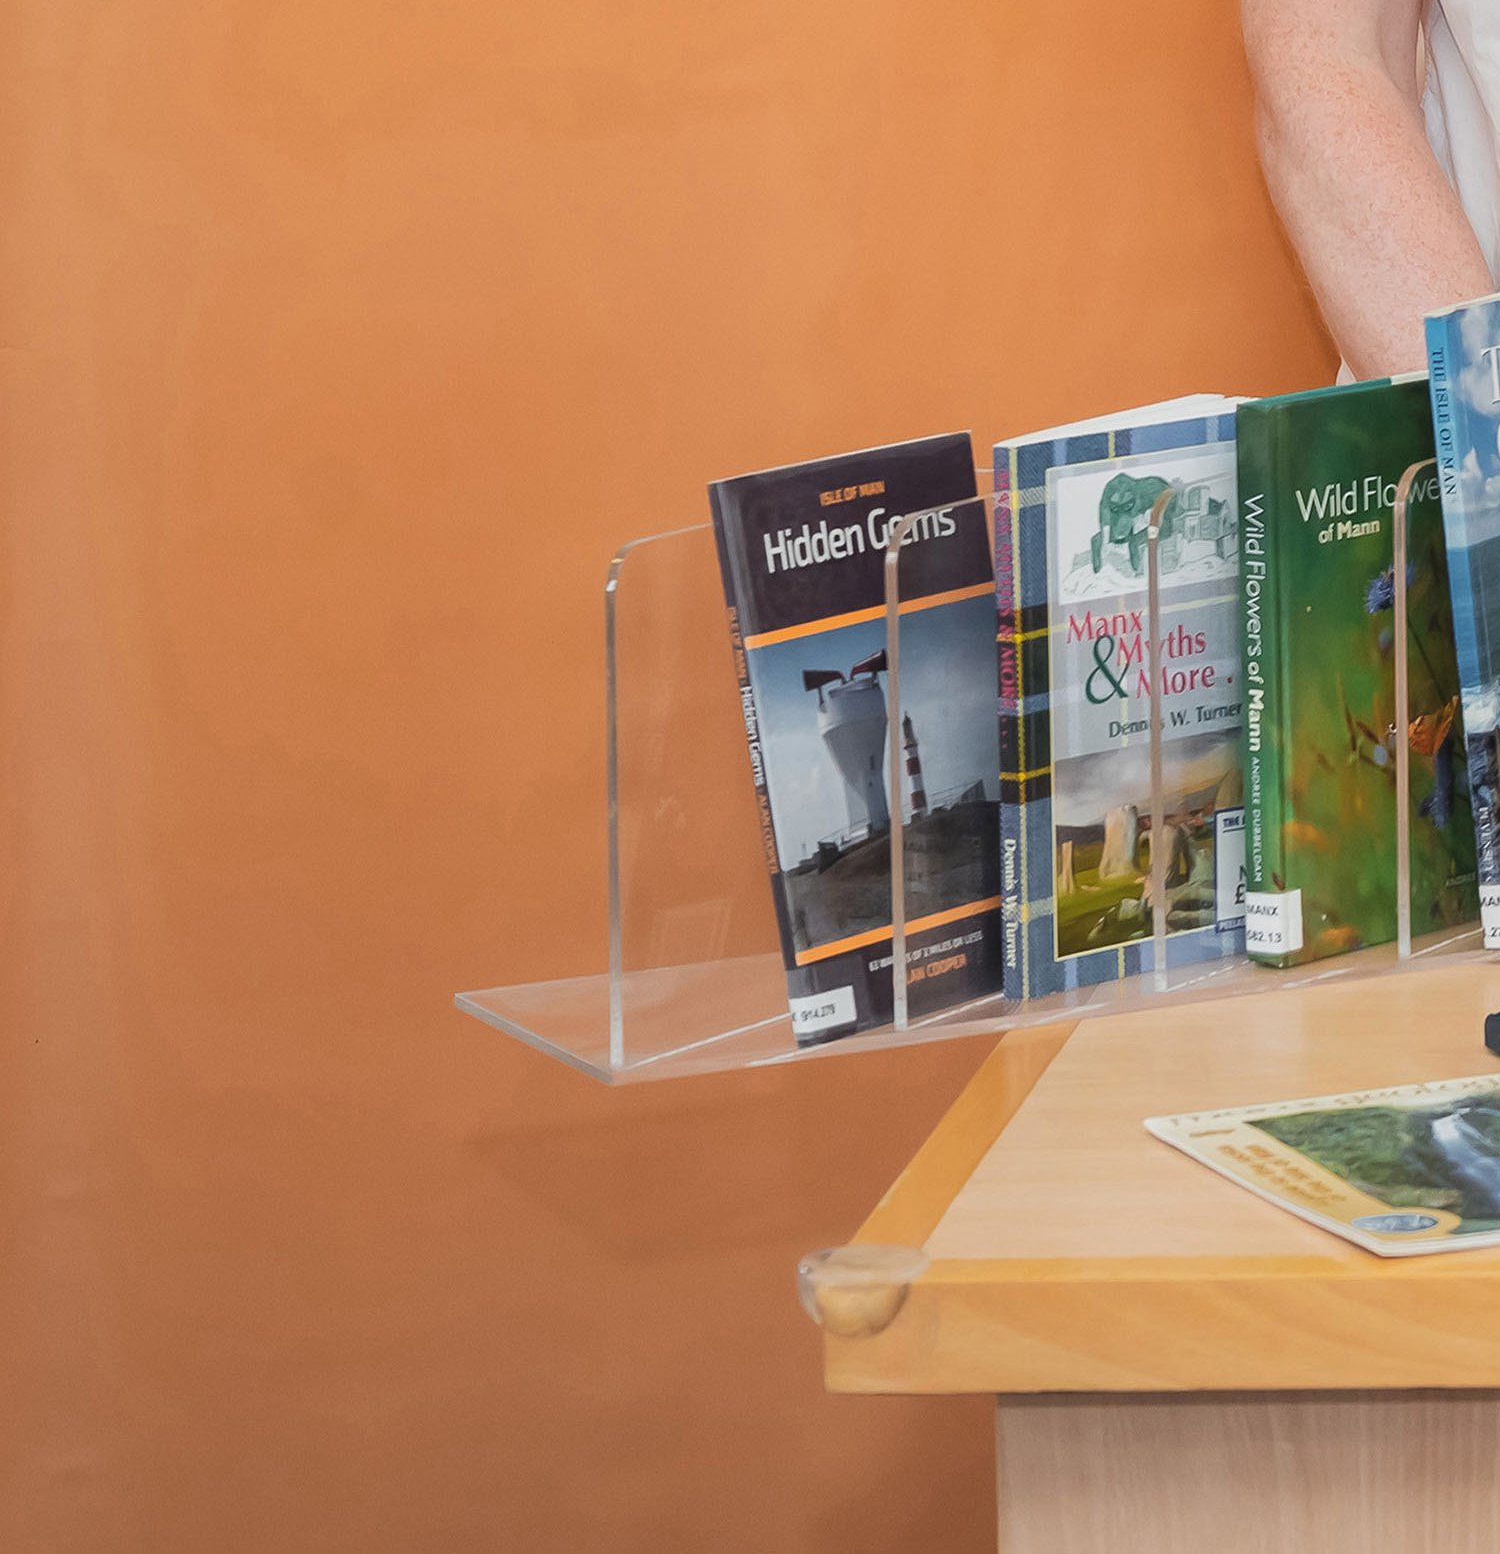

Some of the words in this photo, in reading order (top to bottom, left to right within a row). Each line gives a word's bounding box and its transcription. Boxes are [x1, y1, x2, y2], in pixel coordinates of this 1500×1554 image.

[1243, 493, 1265, 556] Wild
[1295, 480, 1358, 523] Wild
[1364, 475, 1441, 512] Flowe
[763, 520, 865, 574] Hidden
[1318, 523, 1335, 544] of
[1336, 518, 1381, 541] Mann
[1066, 610, 1144, 645] Manx
[1245, 559, 1266, 658] Flowers
[1085, 634, 1131, 706] &
[1247, 660, 1265, 686] of
[1169, 709, 1191, 728] W.
[1196, 702, 1243, 723] Turner
[1248, 689, 1265, 753] Mann
